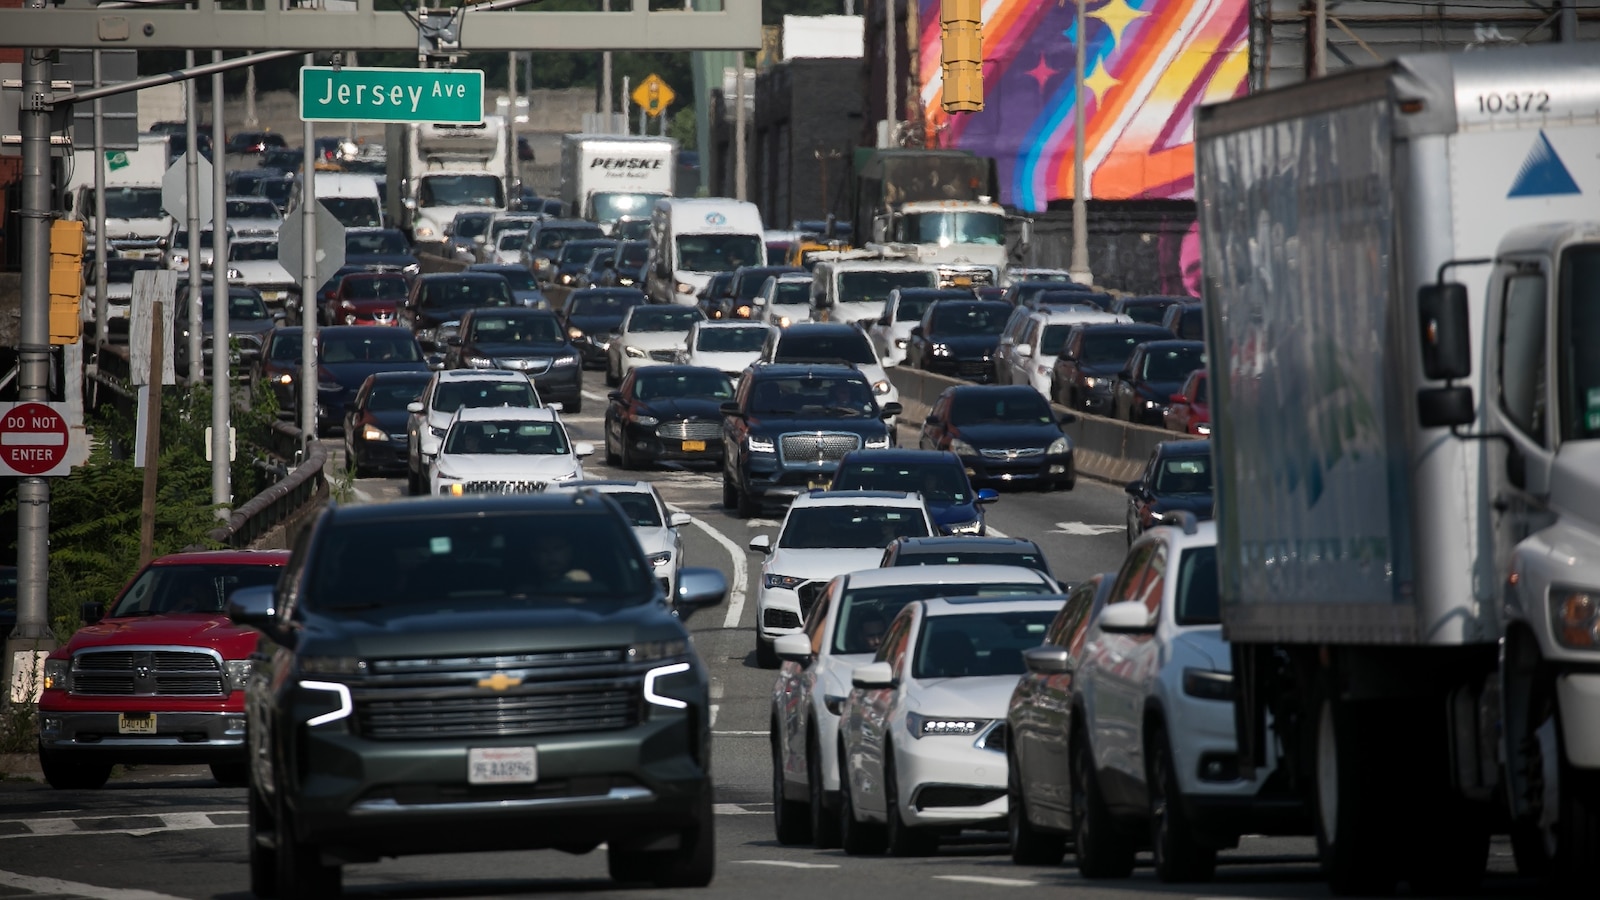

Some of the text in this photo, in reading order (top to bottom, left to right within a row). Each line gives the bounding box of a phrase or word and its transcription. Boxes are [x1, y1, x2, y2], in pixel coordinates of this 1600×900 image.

[318, 78, 466, 112] Jersey Ave
[1477, 91, 1551, 114] 10372
[590, 157, 664, 169] PENSKE
[8, 417, 57, 429] DO NOT
[12, 449, 53, 460] ENTER
